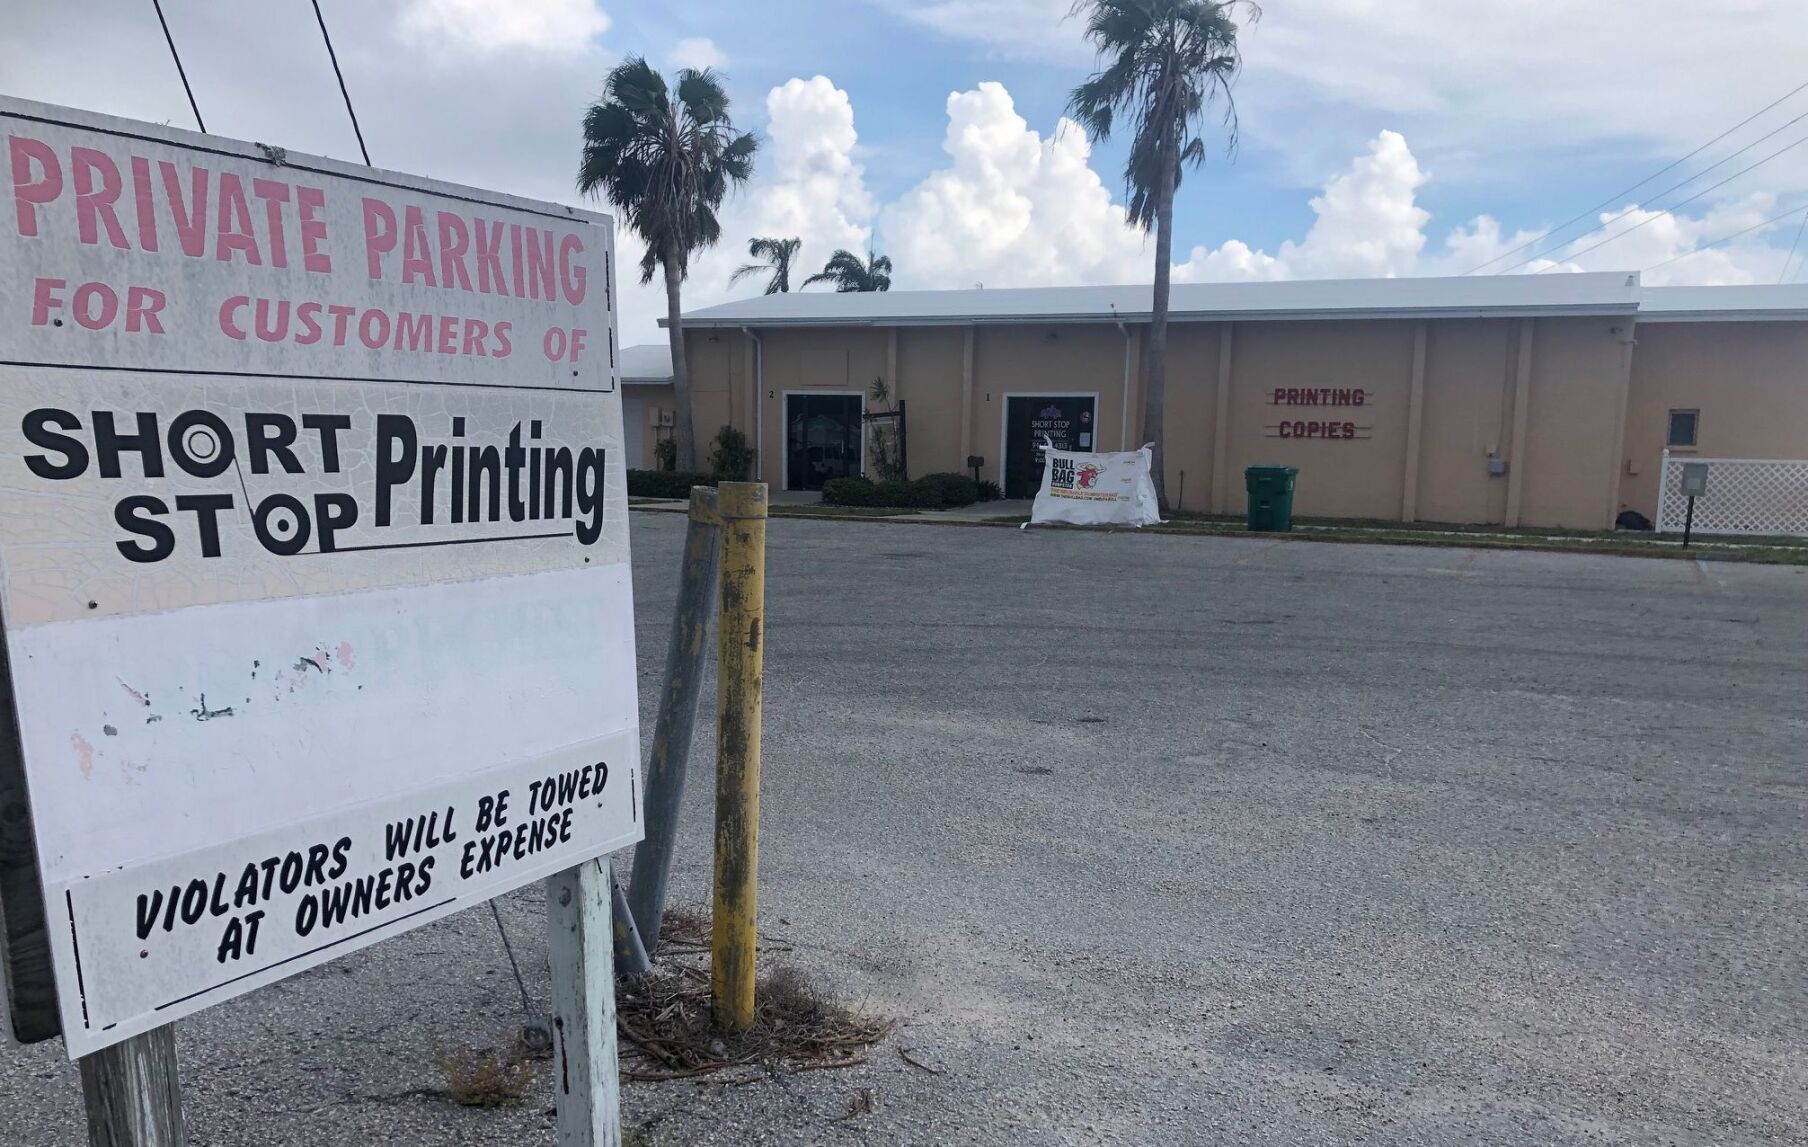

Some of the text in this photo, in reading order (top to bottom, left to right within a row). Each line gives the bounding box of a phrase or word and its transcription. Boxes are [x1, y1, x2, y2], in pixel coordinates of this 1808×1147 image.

[9, 135, 587, 306] PRIVATE PARKING
[32, 278, 587, 362] FOR CUSTOMERS OF
[769, 391, 774, 399] 2
[1031, 420, 1070, 429] SHORT STOP
[1274, 388, 1364, 406] PRINTING
[1280, 421, 1355, 439] COPIES
[21, 407, 351, 480] SHORT
[374, 413, 606, 545] Printing
[1051, 468, 1075, 483] BAG
[1052, 458, 1075, 470] BULL
[114, 492, 358, 563] STOP
[136, 761, 608, 940] VIOLATORS WILL BE TOWED
[217, 807, 573, 964] AT OWNERS EXPENSE
